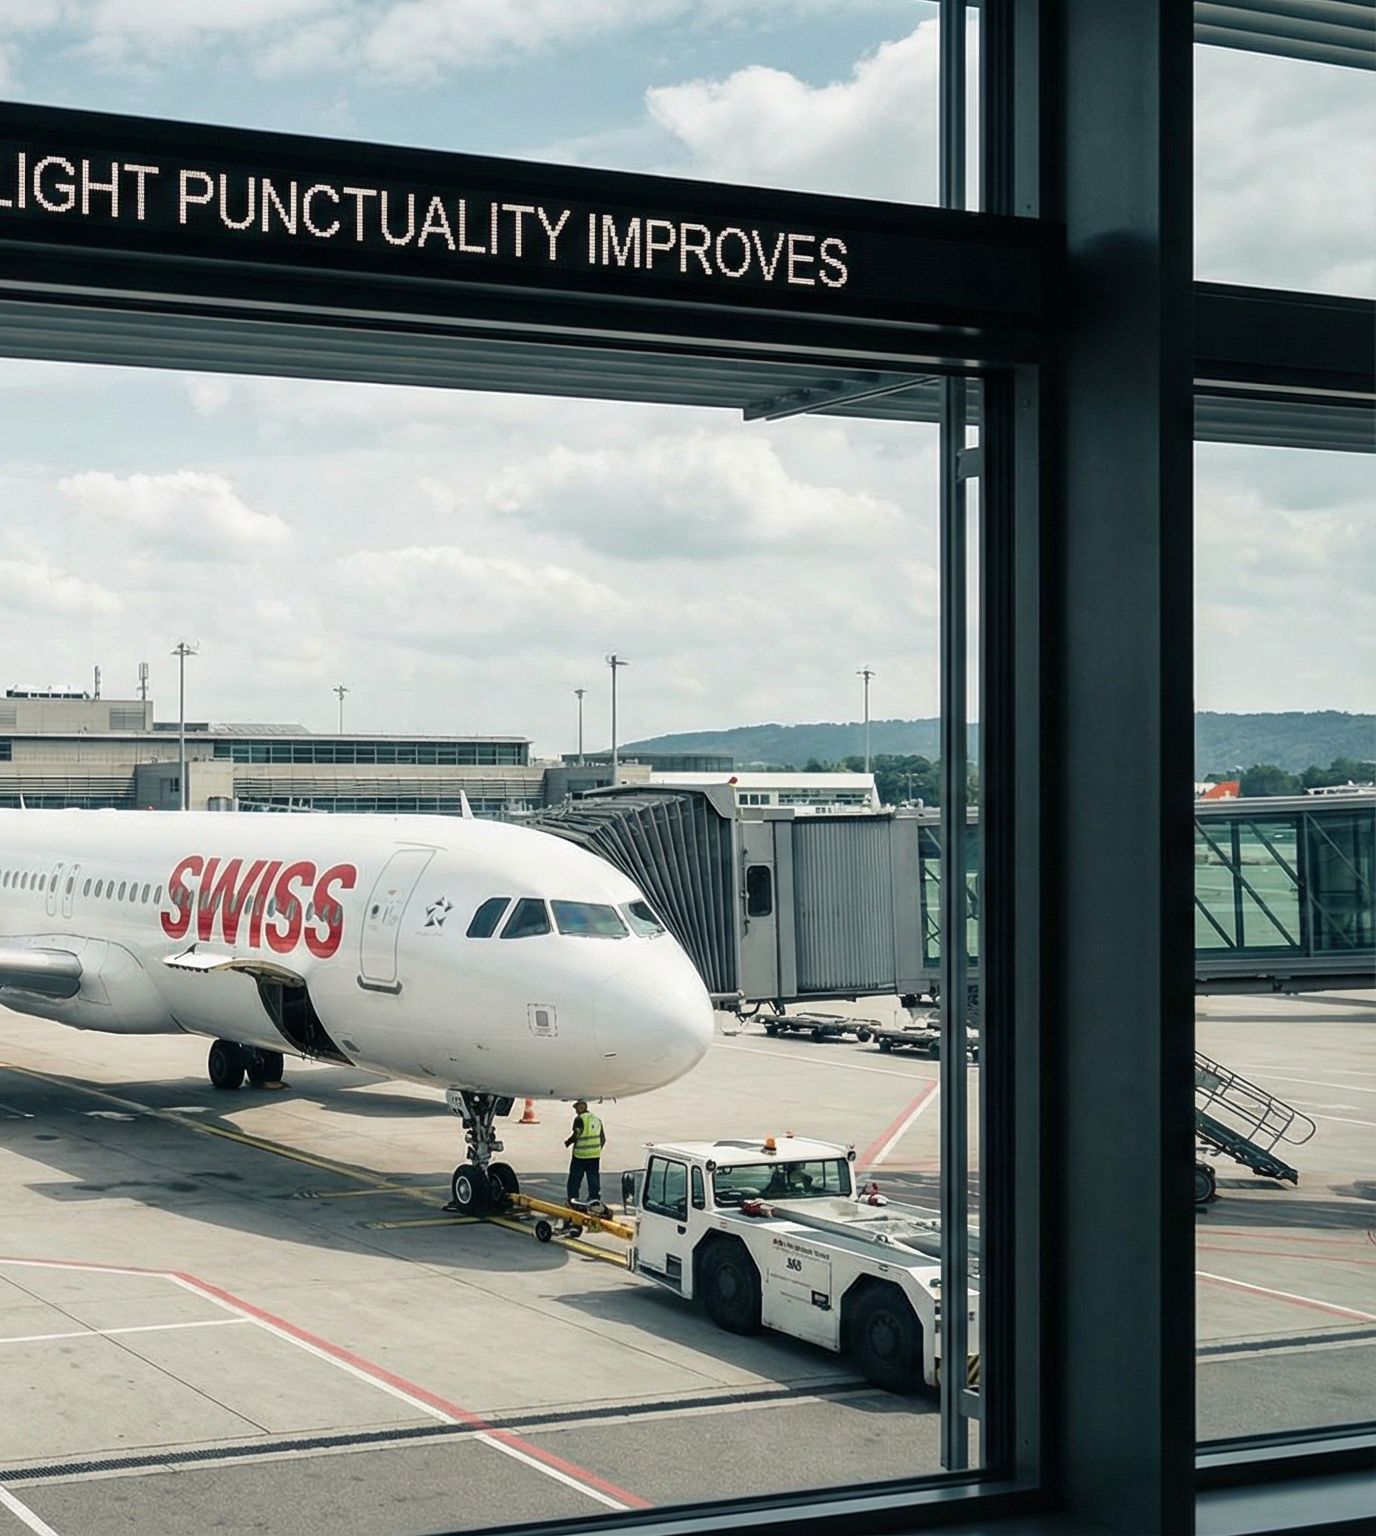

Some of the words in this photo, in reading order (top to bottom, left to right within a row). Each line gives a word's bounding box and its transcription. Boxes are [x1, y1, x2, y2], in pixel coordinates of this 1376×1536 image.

[179, 169, 571, 261] PUNCTUALITY
[588, 213, 848, 288] IMPROVES
[161, 855, 359, 959] SWISS
